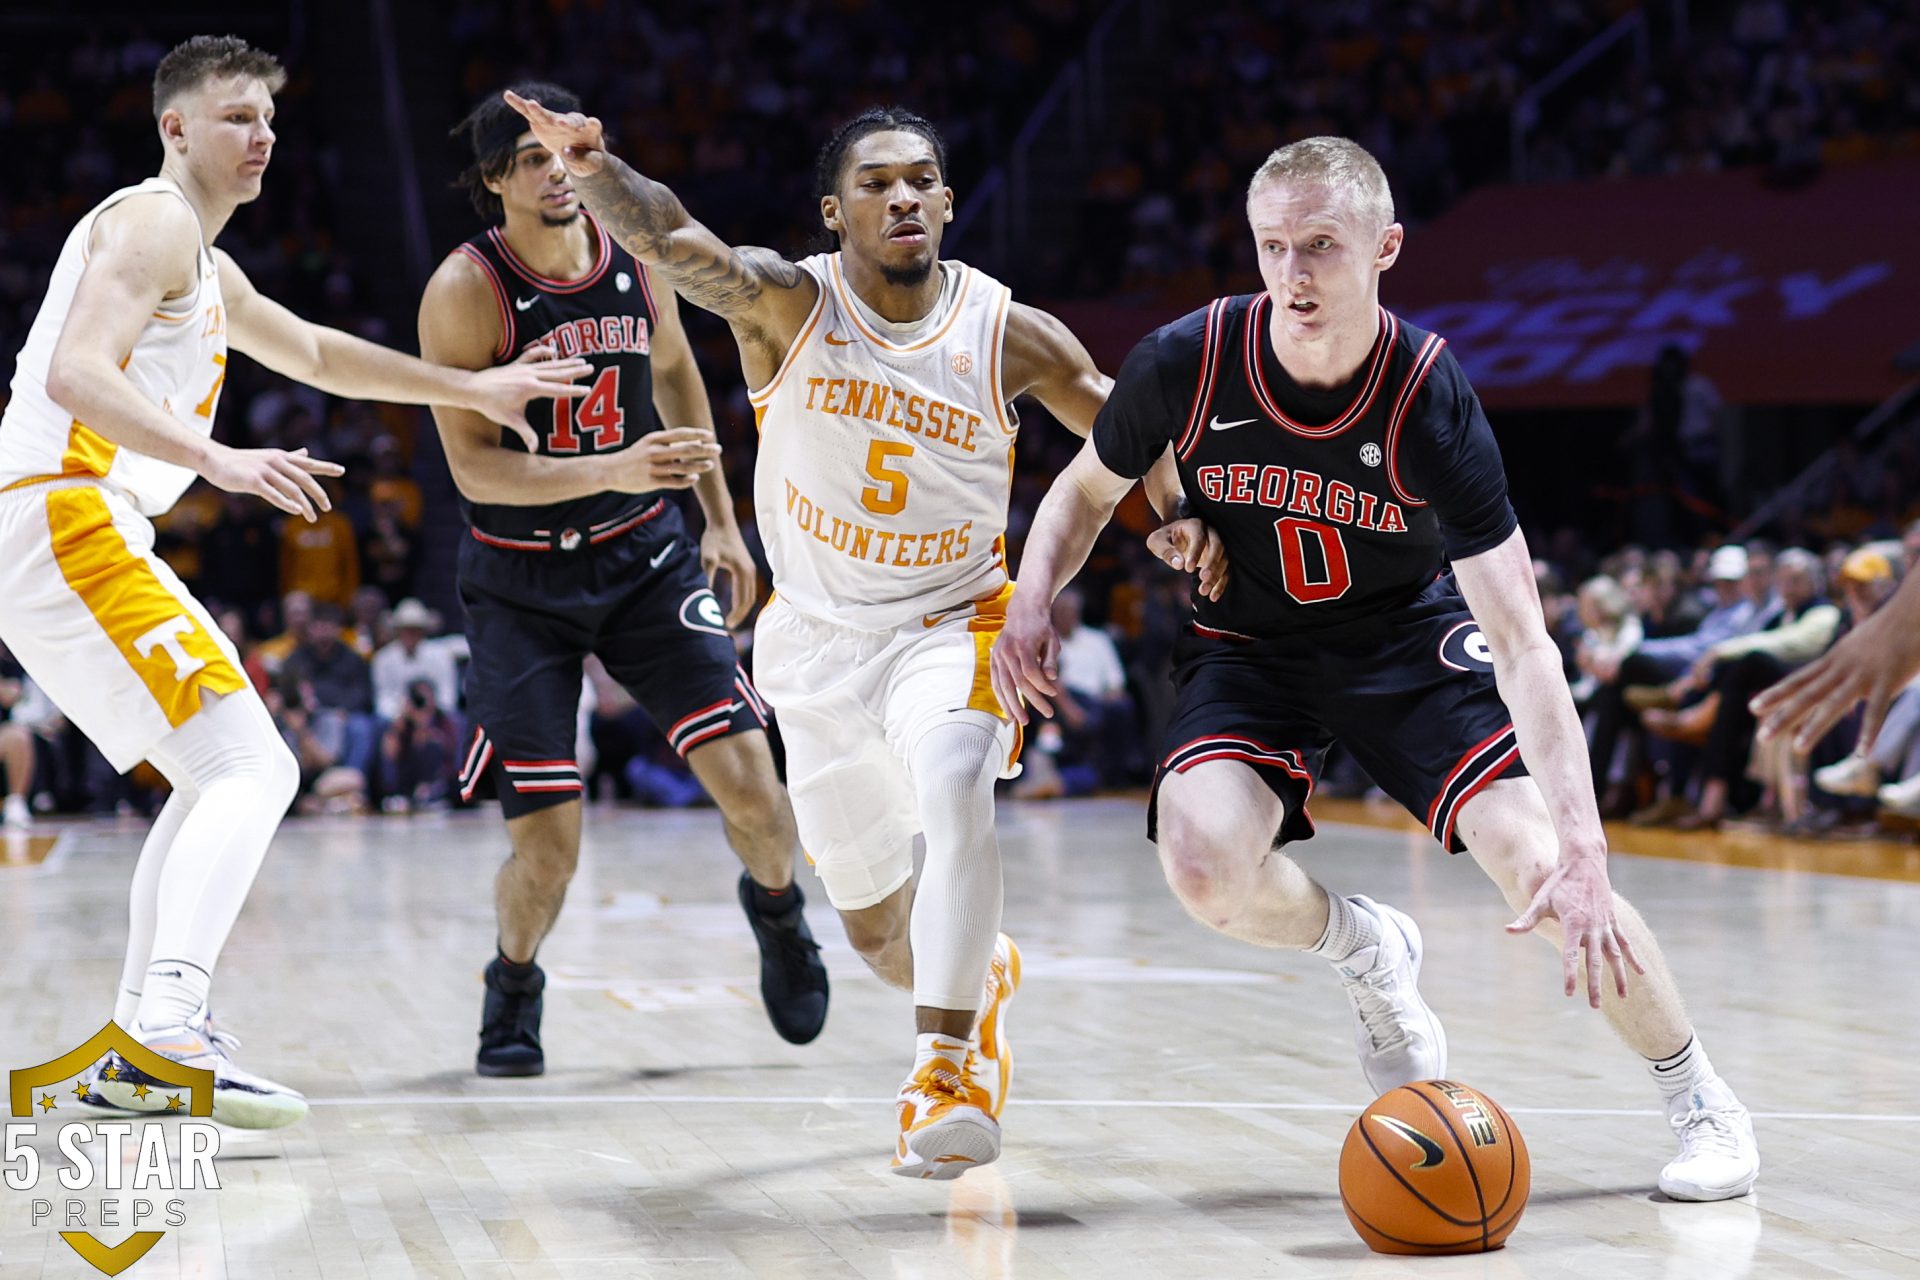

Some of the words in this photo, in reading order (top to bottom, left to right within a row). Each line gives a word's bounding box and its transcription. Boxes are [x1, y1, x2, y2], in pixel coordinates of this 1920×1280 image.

[523, 316, 650, 360] ORGIA
[951, 354, 971, 374] SEC
[547, 365, 625, 453] 14
[806, 376, 982, 453] TENNESSEE
[860, 439, 915, 516] 5
[1361, 443, 1380, 466] SEC
[784, 478, 973, 568] VOLUNTEERS
[1197, 463, 1409, 533] GEORGIA
[1274, 516, 1352, 605] 0
[132, 613, 207, 682] T
[1426, 1080, 1498, 1149] ELITE
